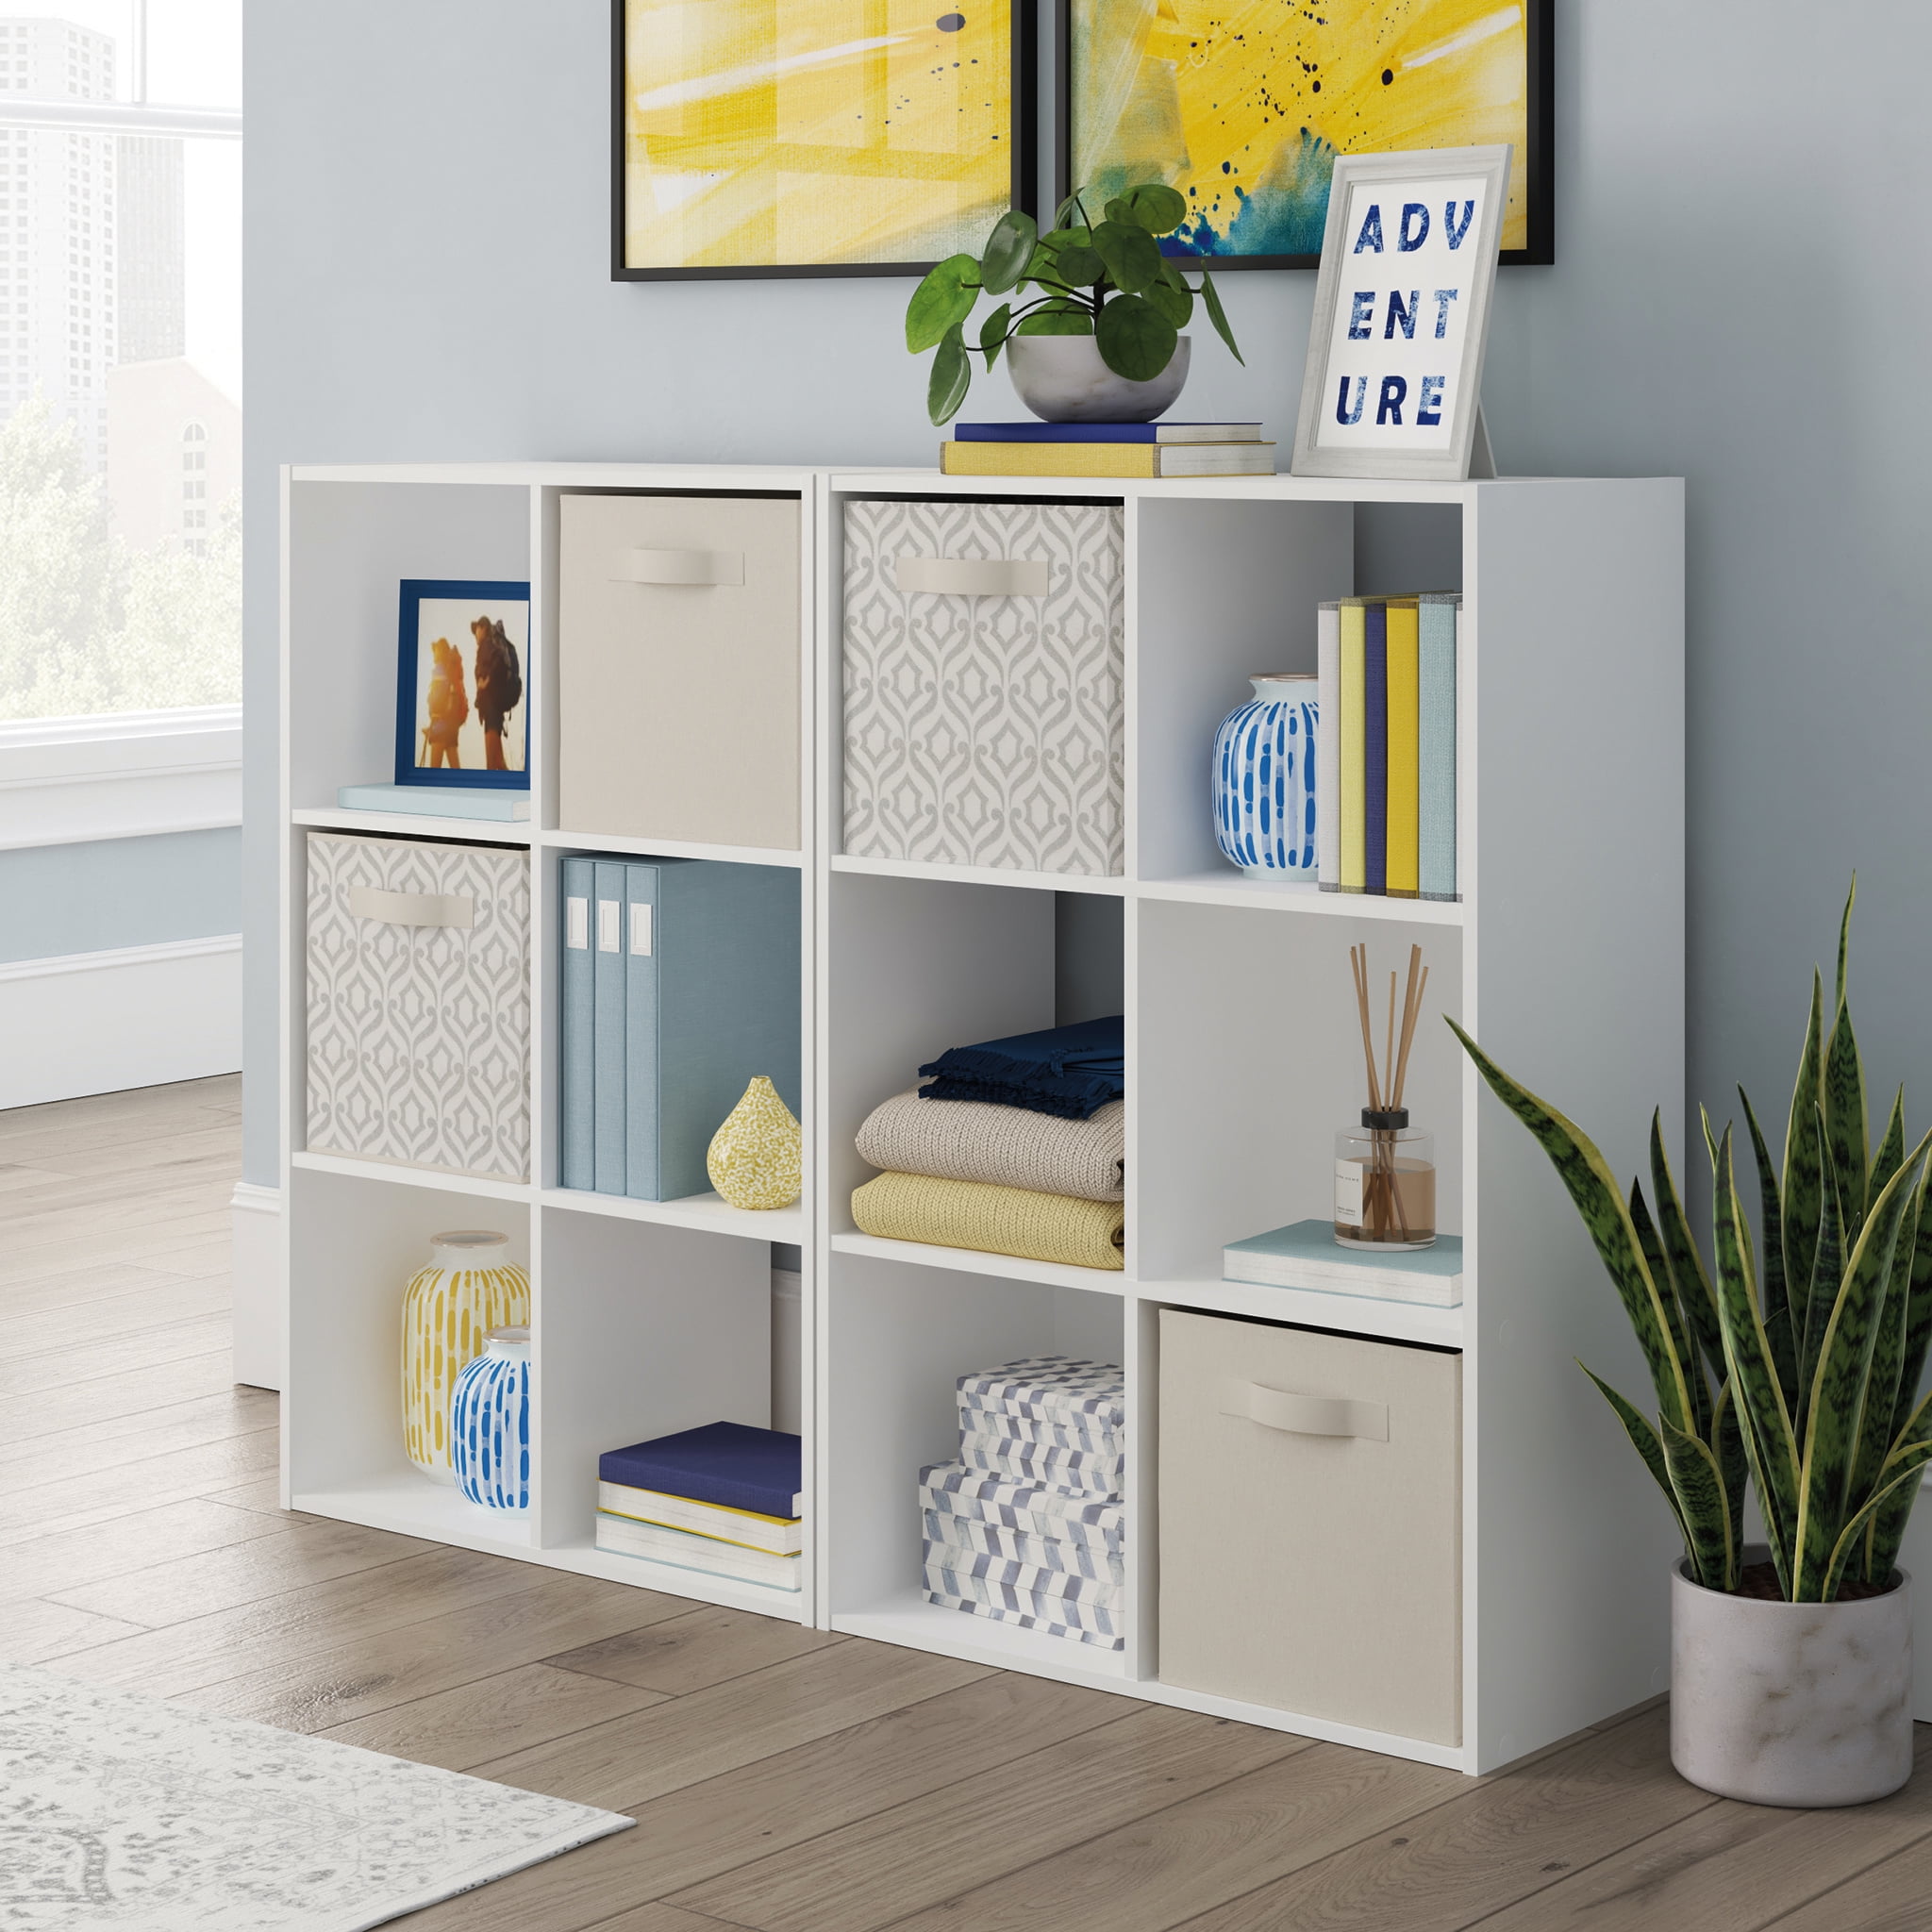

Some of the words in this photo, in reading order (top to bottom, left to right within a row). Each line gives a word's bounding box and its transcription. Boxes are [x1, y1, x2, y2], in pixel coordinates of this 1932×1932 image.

[1353, 199, 1475, 255] ADV
[1348, 289, 1458, 341] ENT
[1336, 375, 1446, 426] URE
